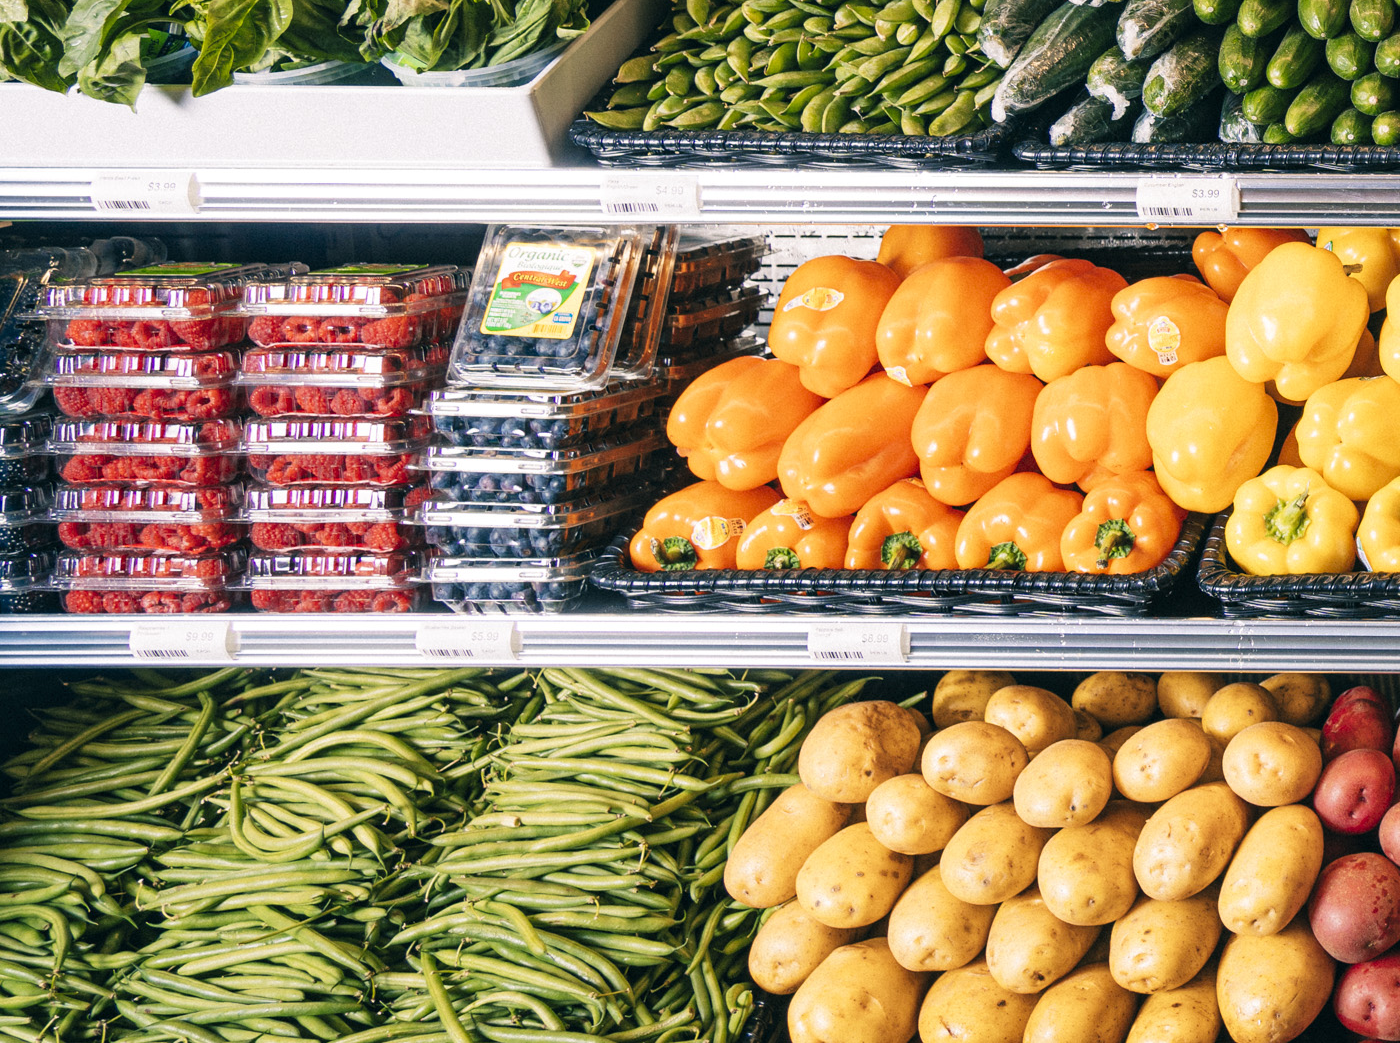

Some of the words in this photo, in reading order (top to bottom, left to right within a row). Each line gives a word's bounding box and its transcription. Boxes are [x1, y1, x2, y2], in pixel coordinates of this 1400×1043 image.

[148, 182, 176, 191] $3.99
[1192, 189, 1219, 198] $3.99
[509, 247, 570, 261] Organic
[513, 273, 545, 282] Central
[548, 278, 568, 287] West
[471, 632, 499, 641] $5.99
